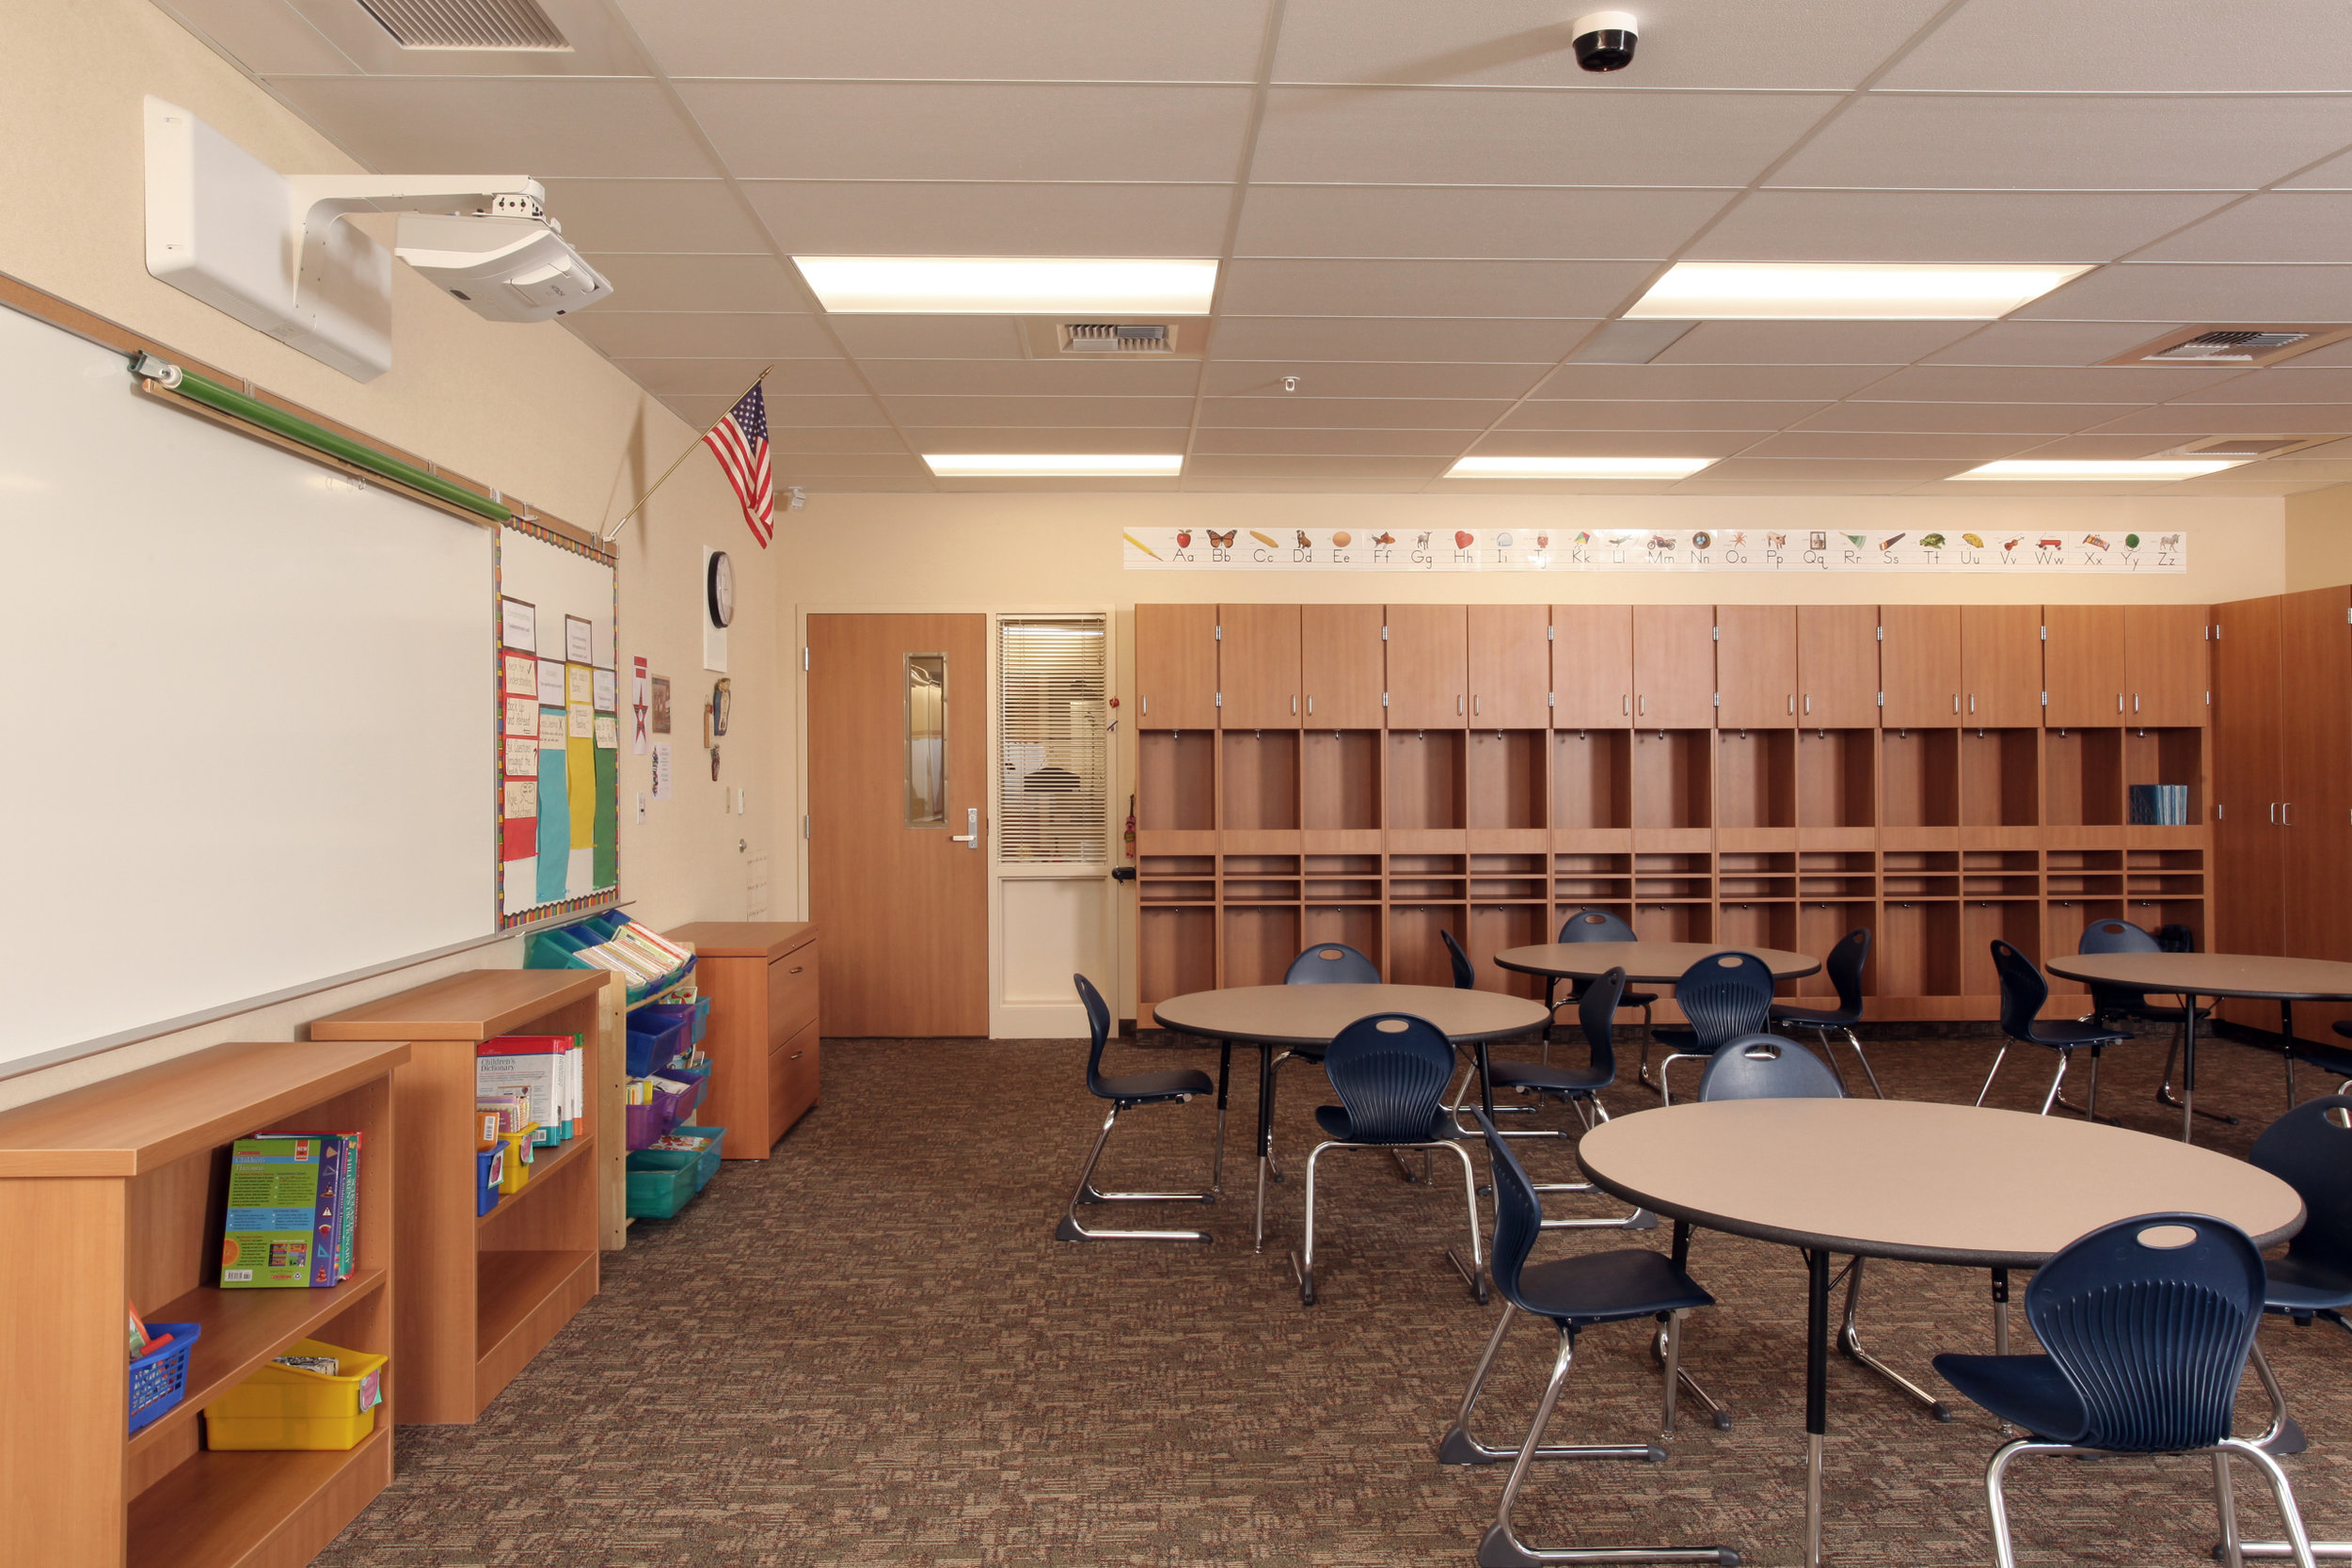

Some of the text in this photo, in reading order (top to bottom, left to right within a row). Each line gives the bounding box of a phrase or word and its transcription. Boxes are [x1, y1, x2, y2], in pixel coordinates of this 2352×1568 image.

[1173, 549, 1194, 562] Aa
[1212, 549, 1232, 562] Bb
[1253, 549, 1274, 562] Cc
[1293, 549, 1312, 562] Dd
[1333, 549, 1350, 562] Ee
[1374, 549, 1392, 563] Ff
[1411, 549, 1433, 569] Gg
[1454, 549, 1472, 563] Hh
[1572, 549, 1591, 563] Kk
[1648, 549, 1675, 563] Mm
[1692, 549, 1709, 563] Nn
[1725, 549, 1747, 563] Oo
[1767, 549, 1783, 569] Pp
[1803, 549, 1828, 570] Qq
[1844, 550, 1862, 564] Rr
[1883, 550, 1899, 564] Ss
[1923, 551, 1940, 564] Tt
[1961, 551, 1980, 564] Uu
[2000, 551, 2017, 564] Vv
[2035, 551, 2064, 565] Ww
[2085, 552, 2103, 565] Xx
[2121, 552, 2139, 571] Yy
[2158, 552, 2175, 565] Zz
